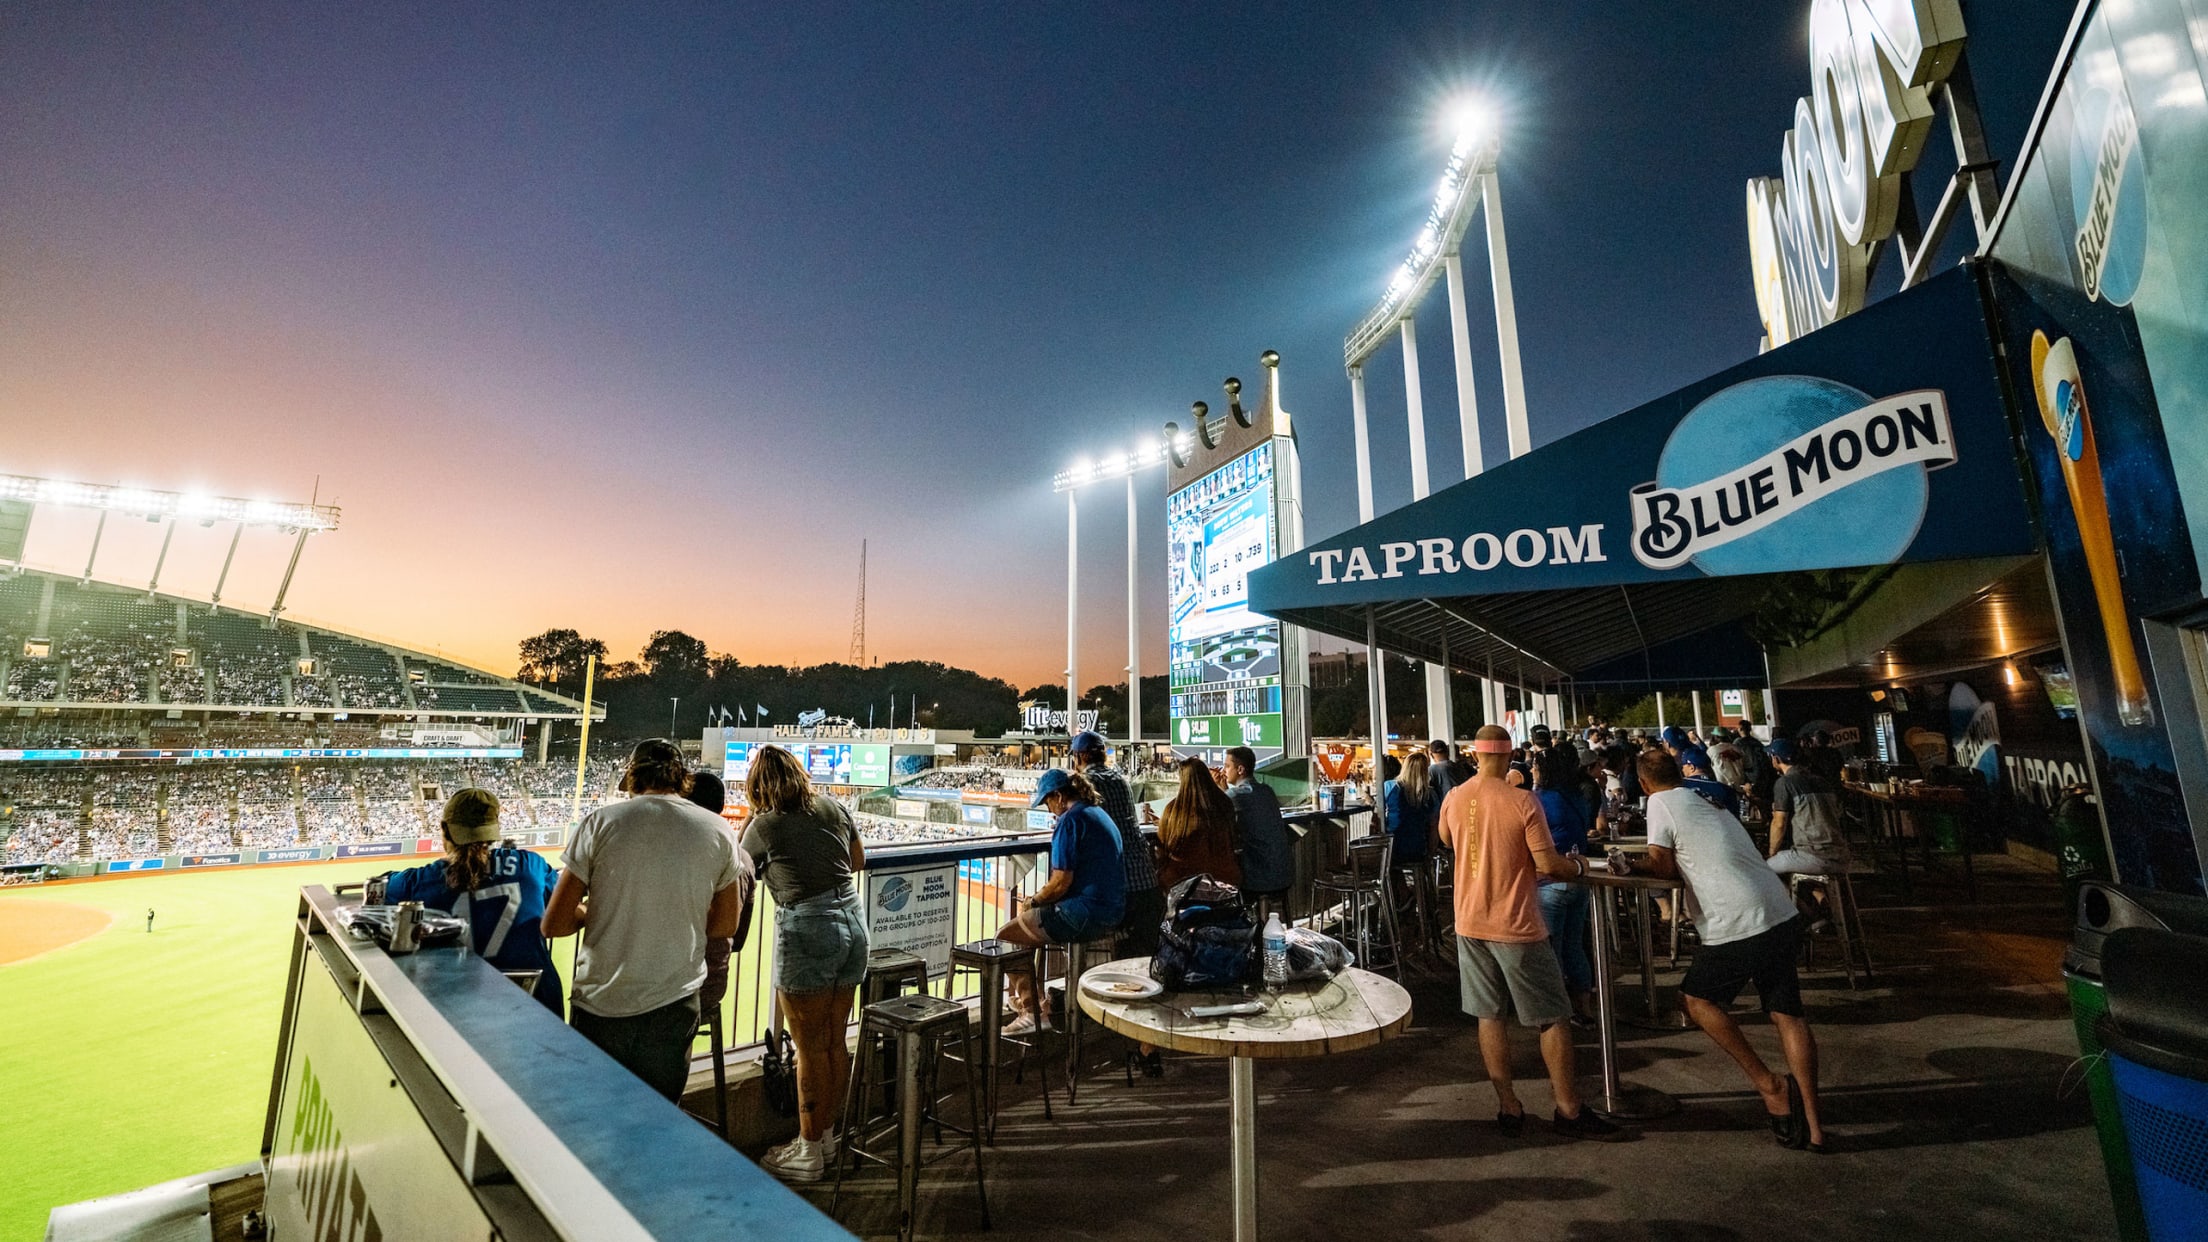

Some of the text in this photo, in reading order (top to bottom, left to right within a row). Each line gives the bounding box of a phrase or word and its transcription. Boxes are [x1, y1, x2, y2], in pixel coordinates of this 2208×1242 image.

[1773, 0, 1923, 340] MOON
[2079, 184, 2109, 296] BLUE
[1639, 402, 1940, 561] BLUE MOON
[1235, 551, 1242, 563] 10
[1246, 542, 1262, 558] .739
[1309, 523, 1607, 585] TAPROOM
[1050, 709, 1098, 732] evgy
[773, 724, 804, 737] HALL
[816, 724, 850, 737] FAME
[897, 727, 908, 740] 10
[920, 727, 928, 740] 5
[1469, 799, 1478, 879] OUTSIDERS
[202, 857, 231, 865] Fanatics
[278, 850, 312, 861] evergy
[925, 875, 943, 884] BLUE
[923, 883, 945, 893] MOON
[916, 891, 950, 902] TAPROOM
[876, 914, 912, 924] AVAILABLE
[923, 907, 948, 916] RESERVE
[873, 925, 887, 933] FOR
[889, 921, 916, 930] GROUPS
[903, 944, 919, 952] 4040
[920, 940, 943, 949] OPTION
[290, 1053, 384, 1242] PRIVAT
